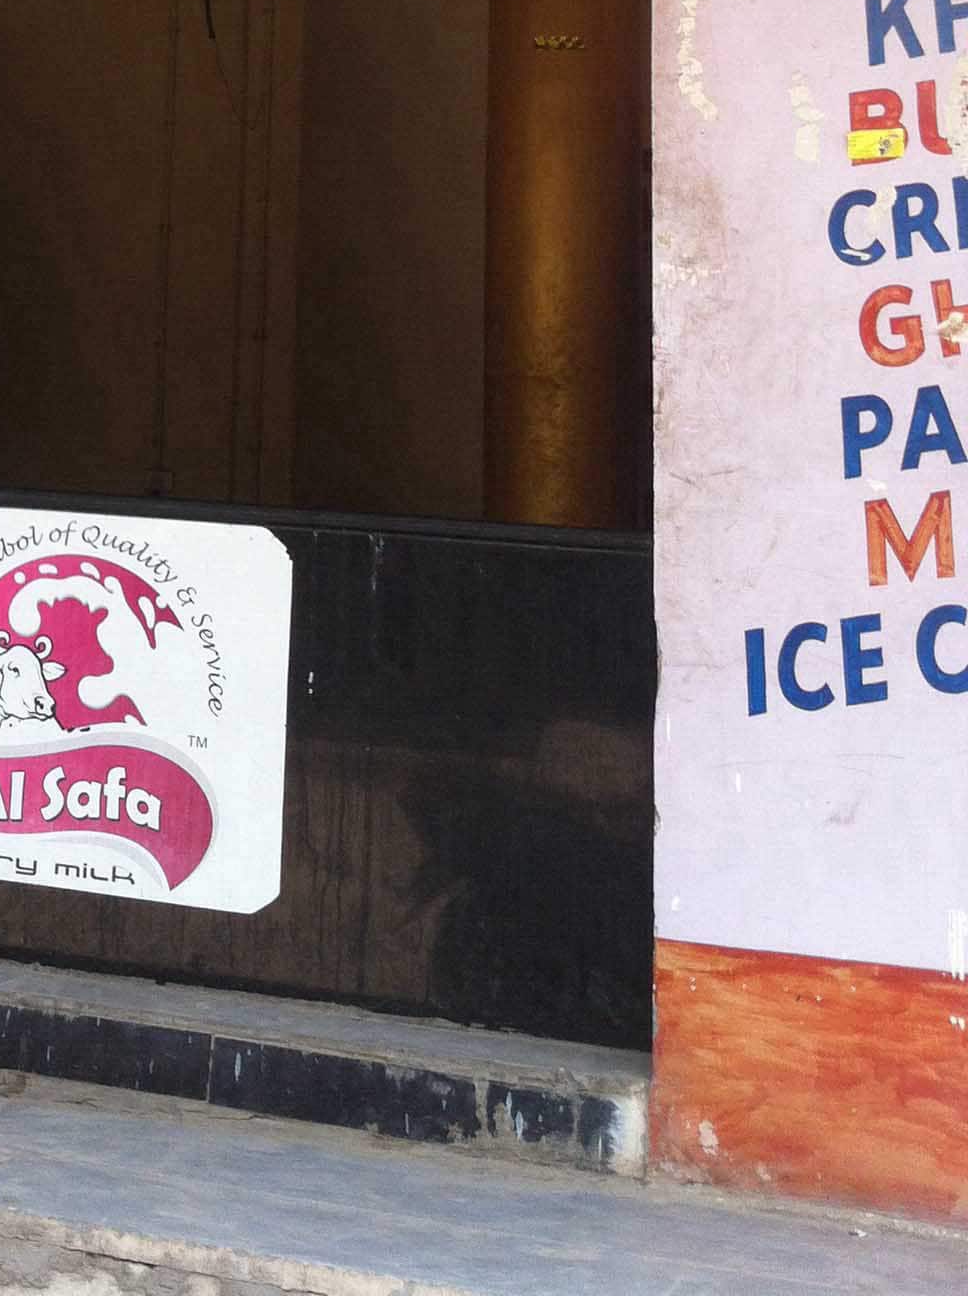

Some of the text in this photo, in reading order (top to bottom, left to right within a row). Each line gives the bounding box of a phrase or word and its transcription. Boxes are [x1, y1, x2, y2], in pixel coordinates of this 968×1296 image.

[828, 176, 968, 266] CR
[841, 385, 968, 479] PA
[49, 520, 77, 546] of
[81, 524, 178, 584] Quality
[175, 586, 198, 609] &
[191, 613, 230, 718] Service
[744, 613, 889, 717] ICE
[188, 735, 208, 748] TM
[40, 766, 162, 830] Safa
[54, 859, 135, 885] milk
